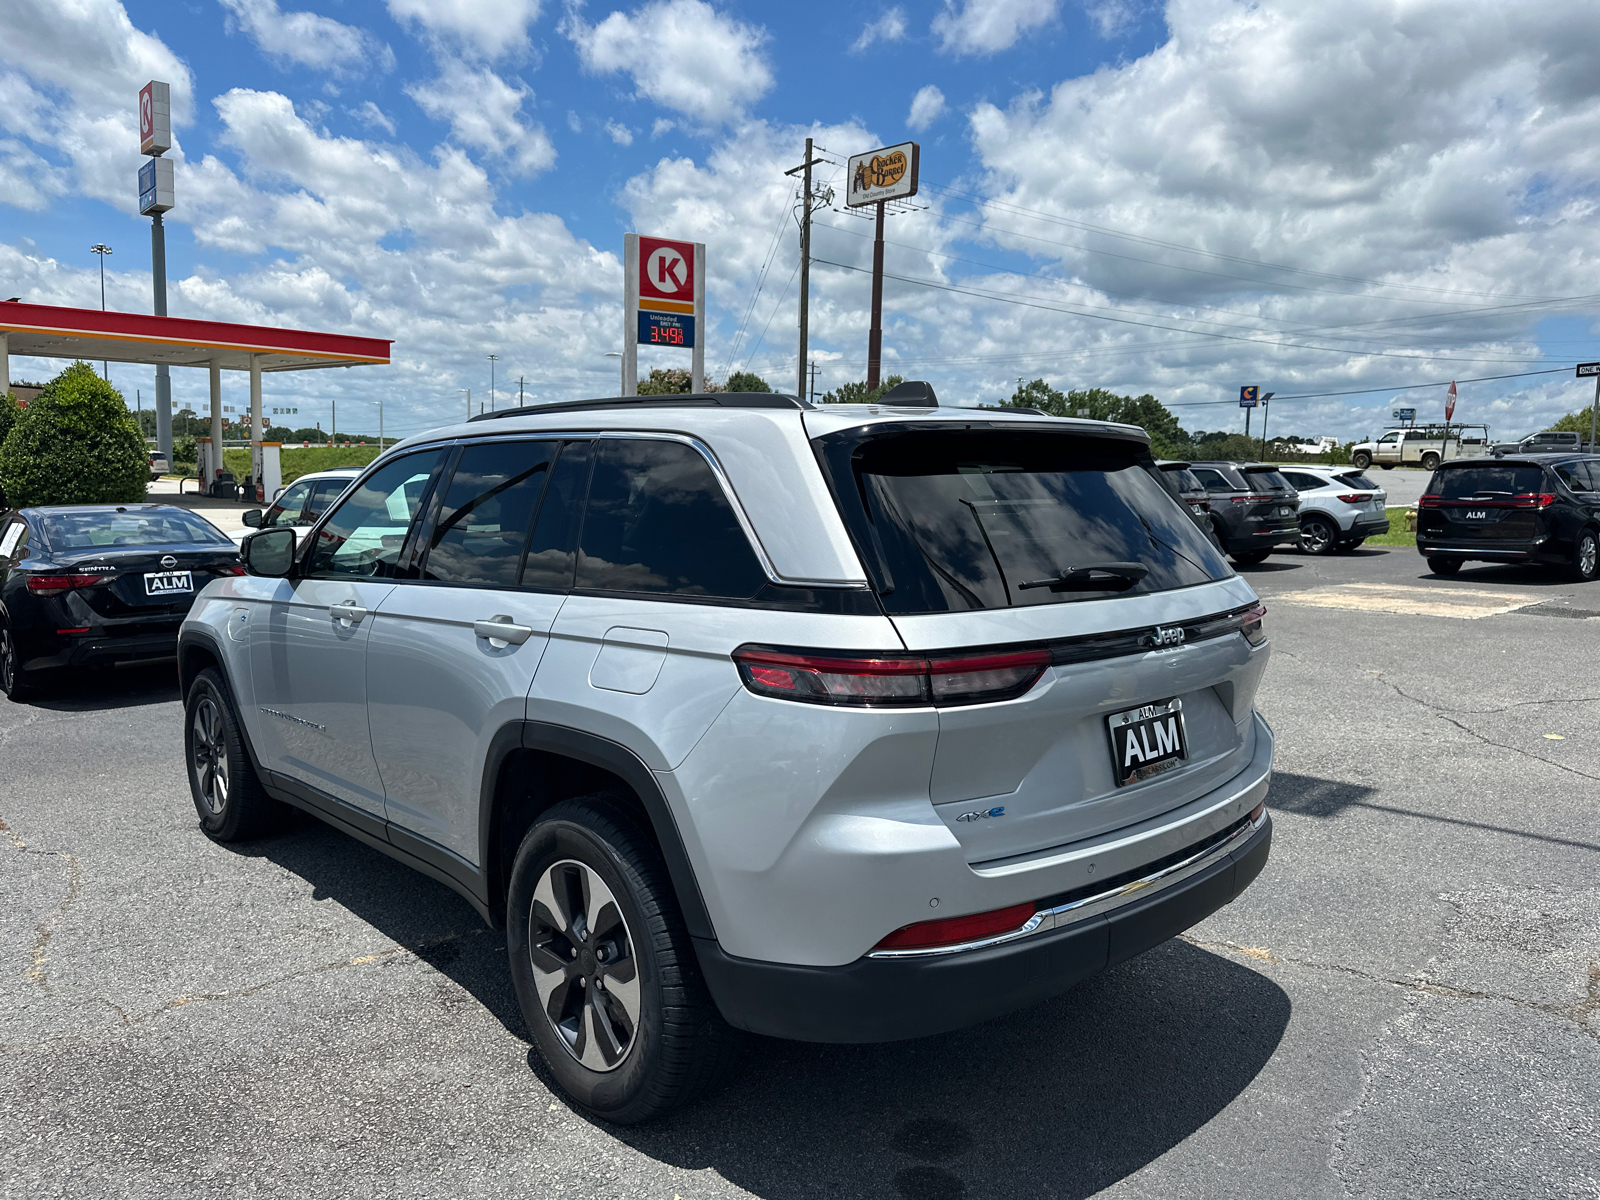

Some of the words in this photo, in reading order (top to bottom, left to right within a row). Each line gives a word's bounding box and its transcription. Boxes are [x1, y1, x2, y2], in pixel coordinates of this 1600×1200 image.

[143, 98, 151, 128] K
[870, 155, 902, 174] Cracker
[876, 164, 904, 186] Barrel
[870, 190, 885, 198] Country
[658, 255, 682, 289] K
[650, 314, 678, 322] Unleaded
[1445, 393, 1456, 409] STOP
[1466, 511, 1486, 519] ALM
[151, 576, 188, 591] ALM
[1152, 626, 1186, 646] Jeep
[1139, 705, 1158, 720] ALM
[1124, 716, 1181, 768] ALM
